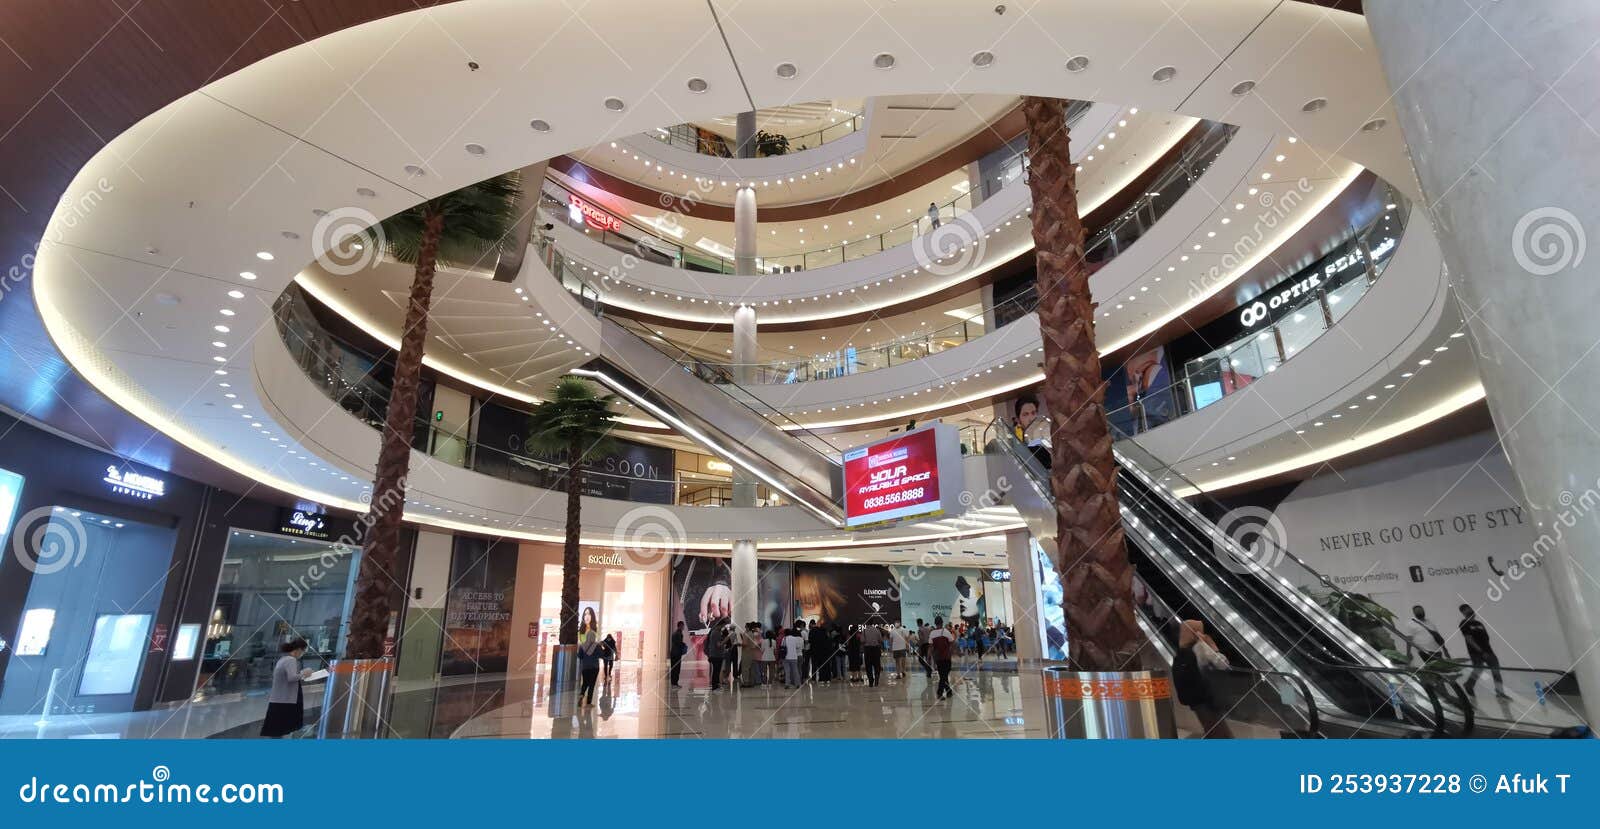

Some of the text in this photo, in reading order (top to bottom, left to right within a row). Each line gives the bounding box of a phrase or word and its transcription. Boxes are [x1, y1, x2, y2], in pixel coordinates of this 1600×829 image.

[1269, 273, 1321, 309] OPTIK
[605, 457, 659, 480] SOON
[870, 465, 907, 484] YOUR
[901, 471, 931, 485] SPACE
[864, 487, 924, 509] 0838.556.8888
[1320, 506, 1525, 551] NEVER GO OUT OF STY
